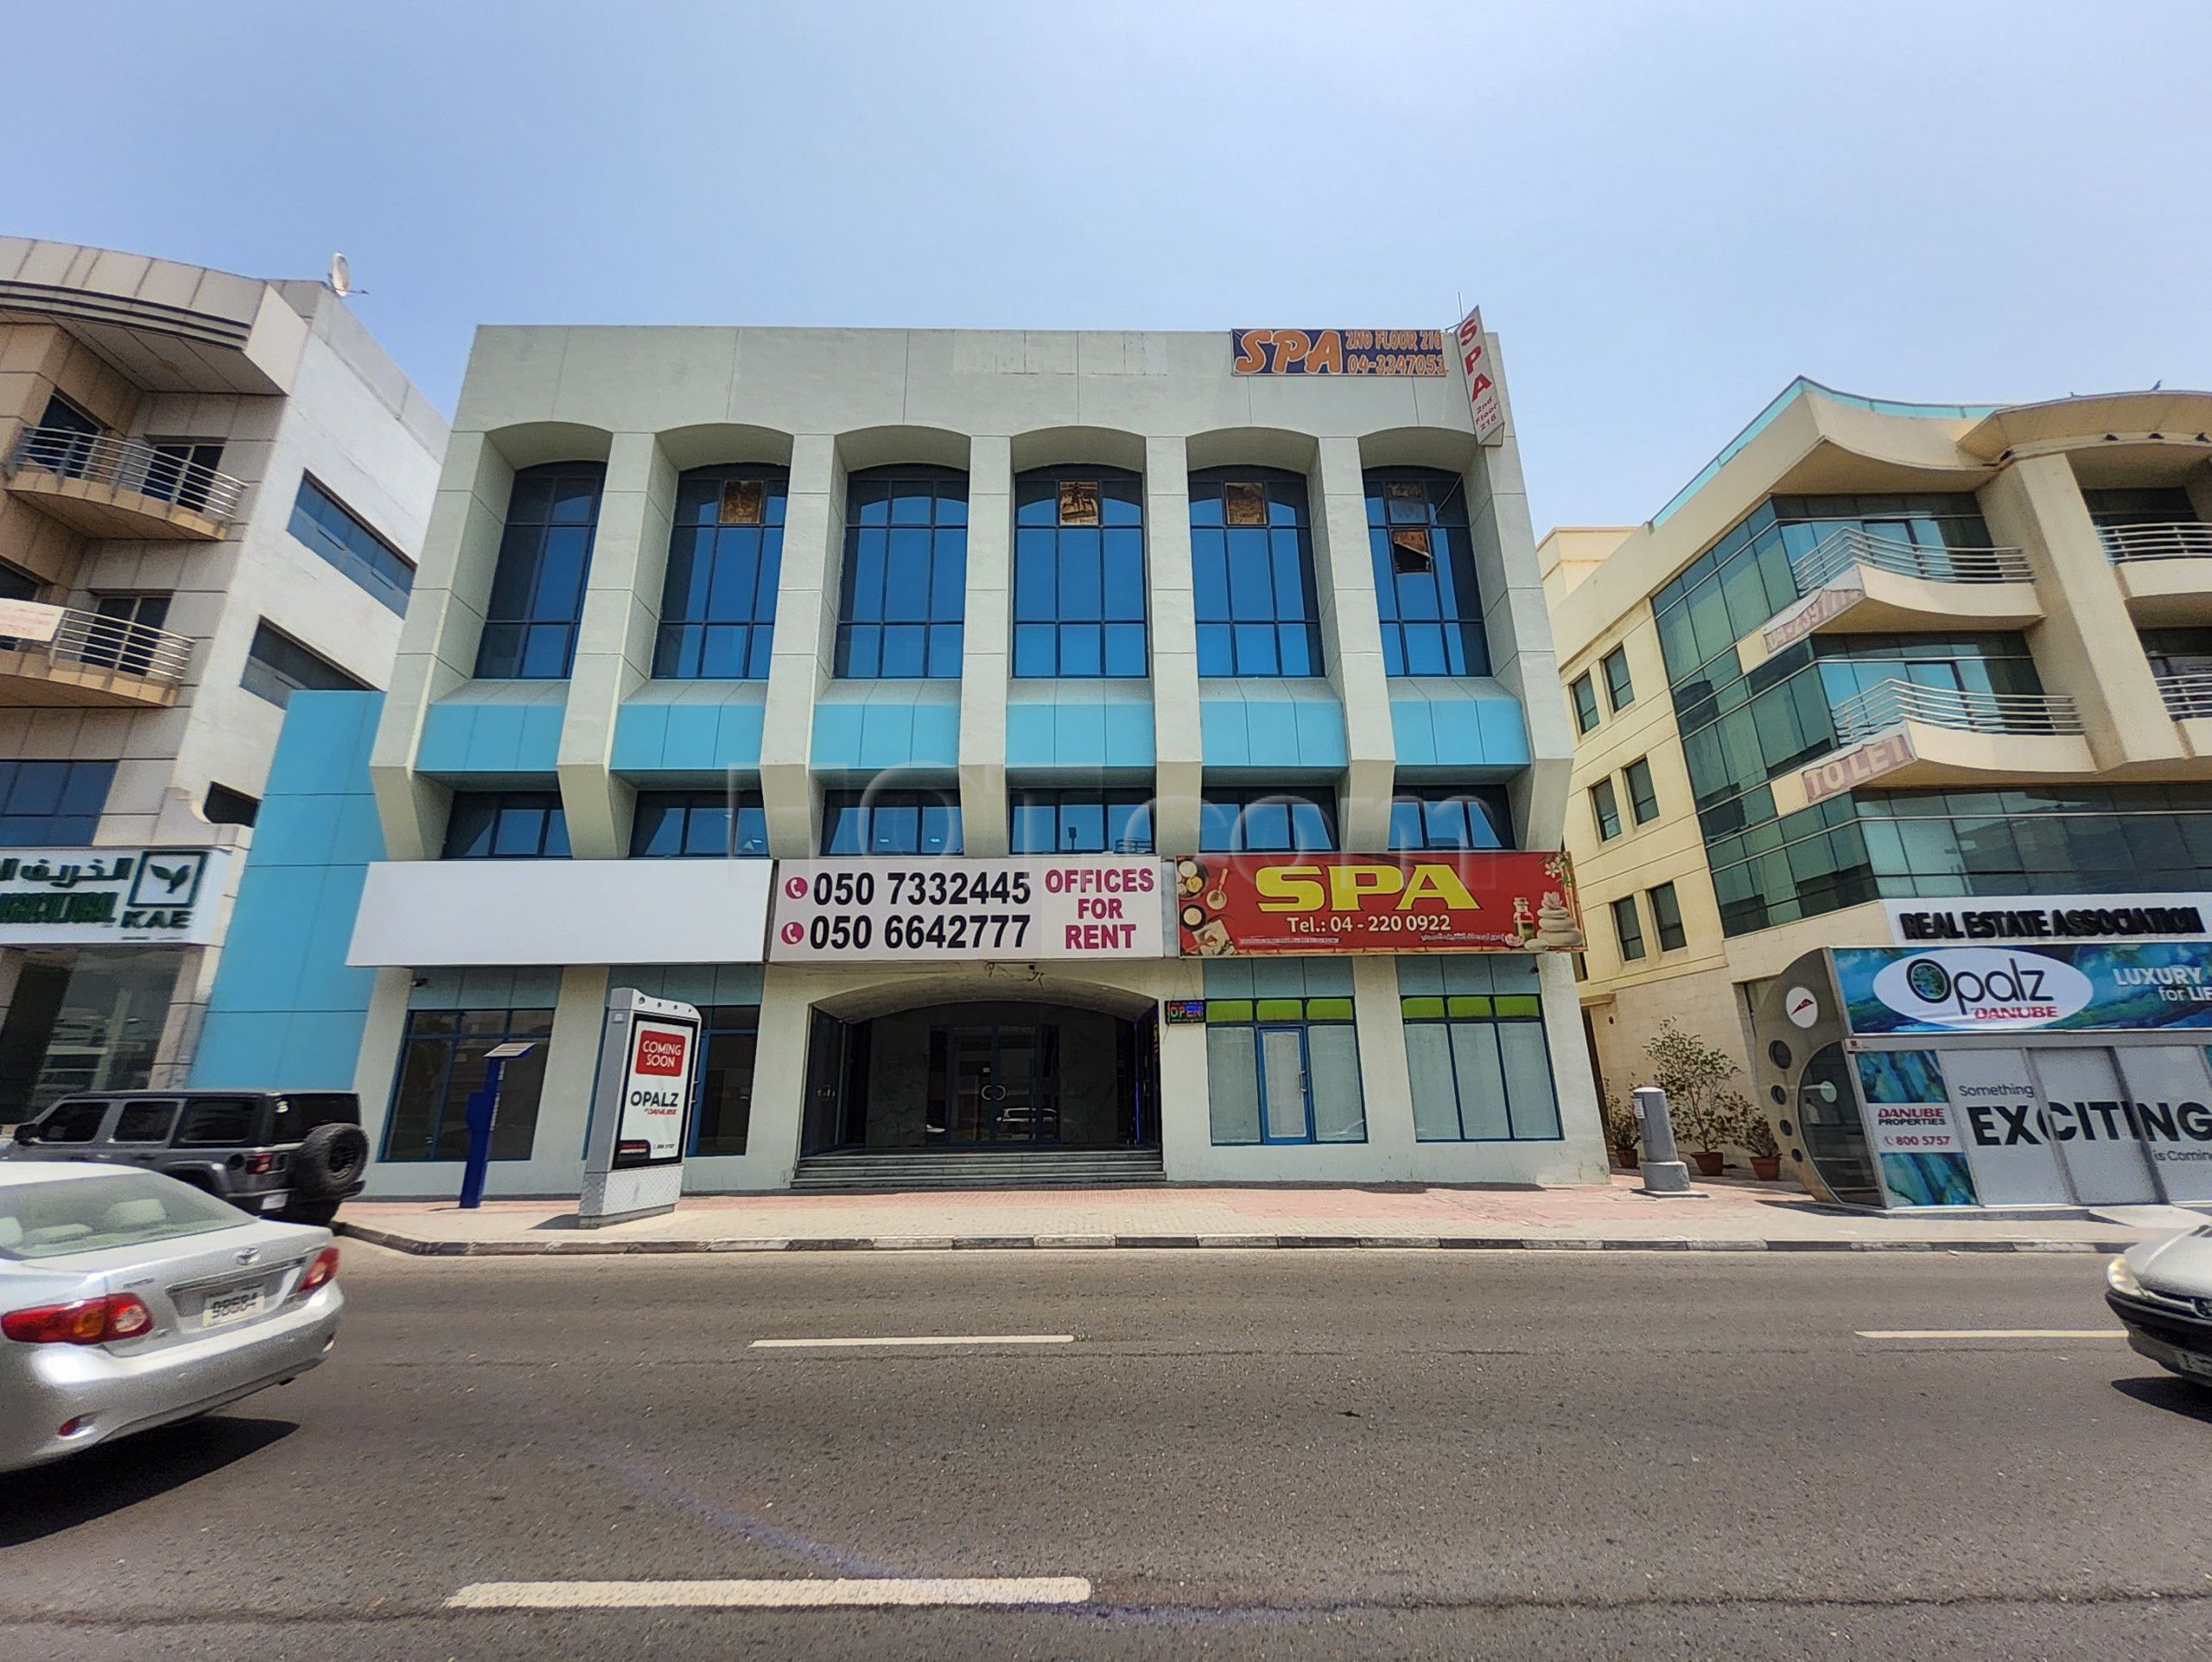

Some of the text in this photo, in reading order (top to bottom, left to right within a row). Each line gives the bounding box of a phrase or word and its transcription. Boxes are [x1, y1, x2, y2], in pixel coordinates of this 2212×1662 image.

[1234, 329, 1343, 373] SPA
[1344, 330, 1372, 350] 2ND
[1376, 330, 1418, 352] FLOOR
[1347, 354, 1446, 374] 04-3347053
[1460, 317, 1492, 403] SPA
[1475, 402, 1500, 424] Floor
[1476, 396, 1493, 415] 2nd
[1479, 414, 1497, 432] 216
[1802, 737, 1905, 797] TO LET
[813, 871, 1031, 906] 050 7332445
[1045, 868, 1155, 894] OFFICES
[1255, 864, 1484, 912] SPA
[1077, 898, 1123, 920] FOR
[120, 910, 194, 929] KAE
[1287, 917, 1325, 933] Tel.:
[1330, 916, 1353, 933] 04
[1368, 915, 1402, 933] 220
[1406, 914, 1452, 932] 0922
[1899, 907, 2206, 940] REAL ESTATE ASSOCIATION
[810, 914, 1031, 949] 050 6642777
[1065, 924, 1137, 949] RENT
[2113, 966, 2202, 986] LUXURY
[1906, 958, 2055, 1016] Opalz
[2158, 986, 2184, 1002] for
[1171, 1005, 1204, 1019] OPEN
[1975, 1006, 2060, 1020] DANUBE
[643, 1040, 682, 1056] COMING
[645, 1054, 676, 1067] SOON
[630, 1091, 679, 1107] OPALZ
[1958, 1084, 2035, 1098] Something
[1878, 1108, 1946, 1118] DANUBE
[1878, 1118, 1946, 1126] PROPERTIES
[1967, 1100, 2212, 1147] EXCITING
[1896, 1136, 1951, 1146] 800 5757
[2167, 1149, 2212, 1162] Comin
